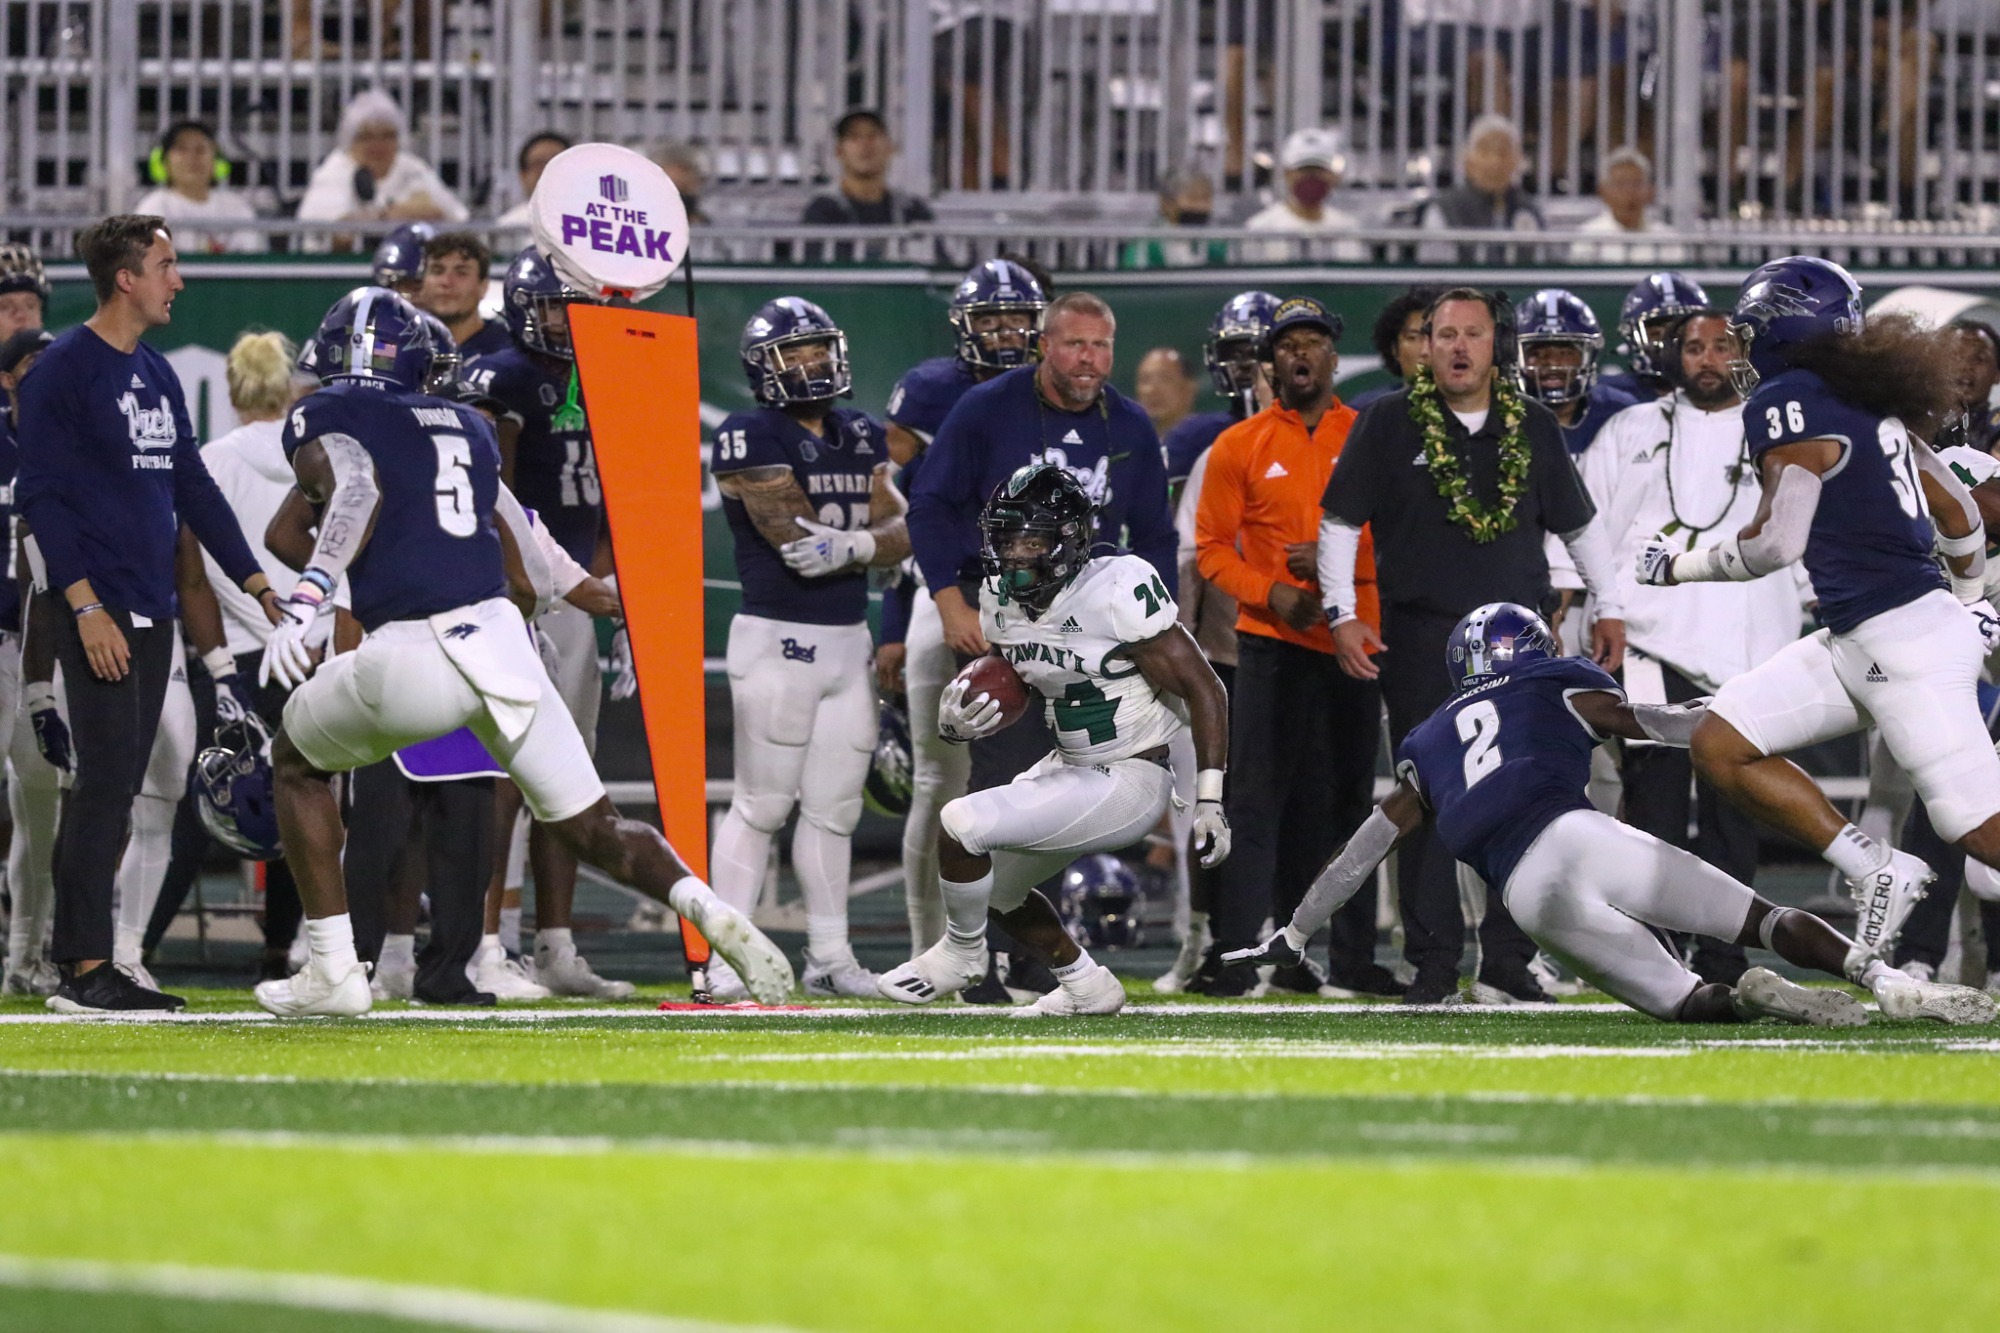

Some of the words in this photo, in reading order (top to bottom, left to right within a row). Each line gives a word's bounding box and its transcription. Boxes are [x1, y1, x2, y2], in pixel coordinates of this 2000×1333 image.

[586, 202, 607, 218] AT
[611, 206, 648, 225] THE
[562, 214, 673, 262] PEAK
[359, 379, 386, 391] PACK
[291, 405, 307, 438] 5
[411, 407, 463, 430] JOHNSON
[1766, 401, 1805, 440] 36
[719, 430, 748, 460] 35
[432, 435, 477, 538] 5
[1133, 574, 1172, 619] 24
[1059, 625, 1083, 633] adidas
[1865, 675, 1889, 683] adidas
[1455, 698, 1504, 792] 2
